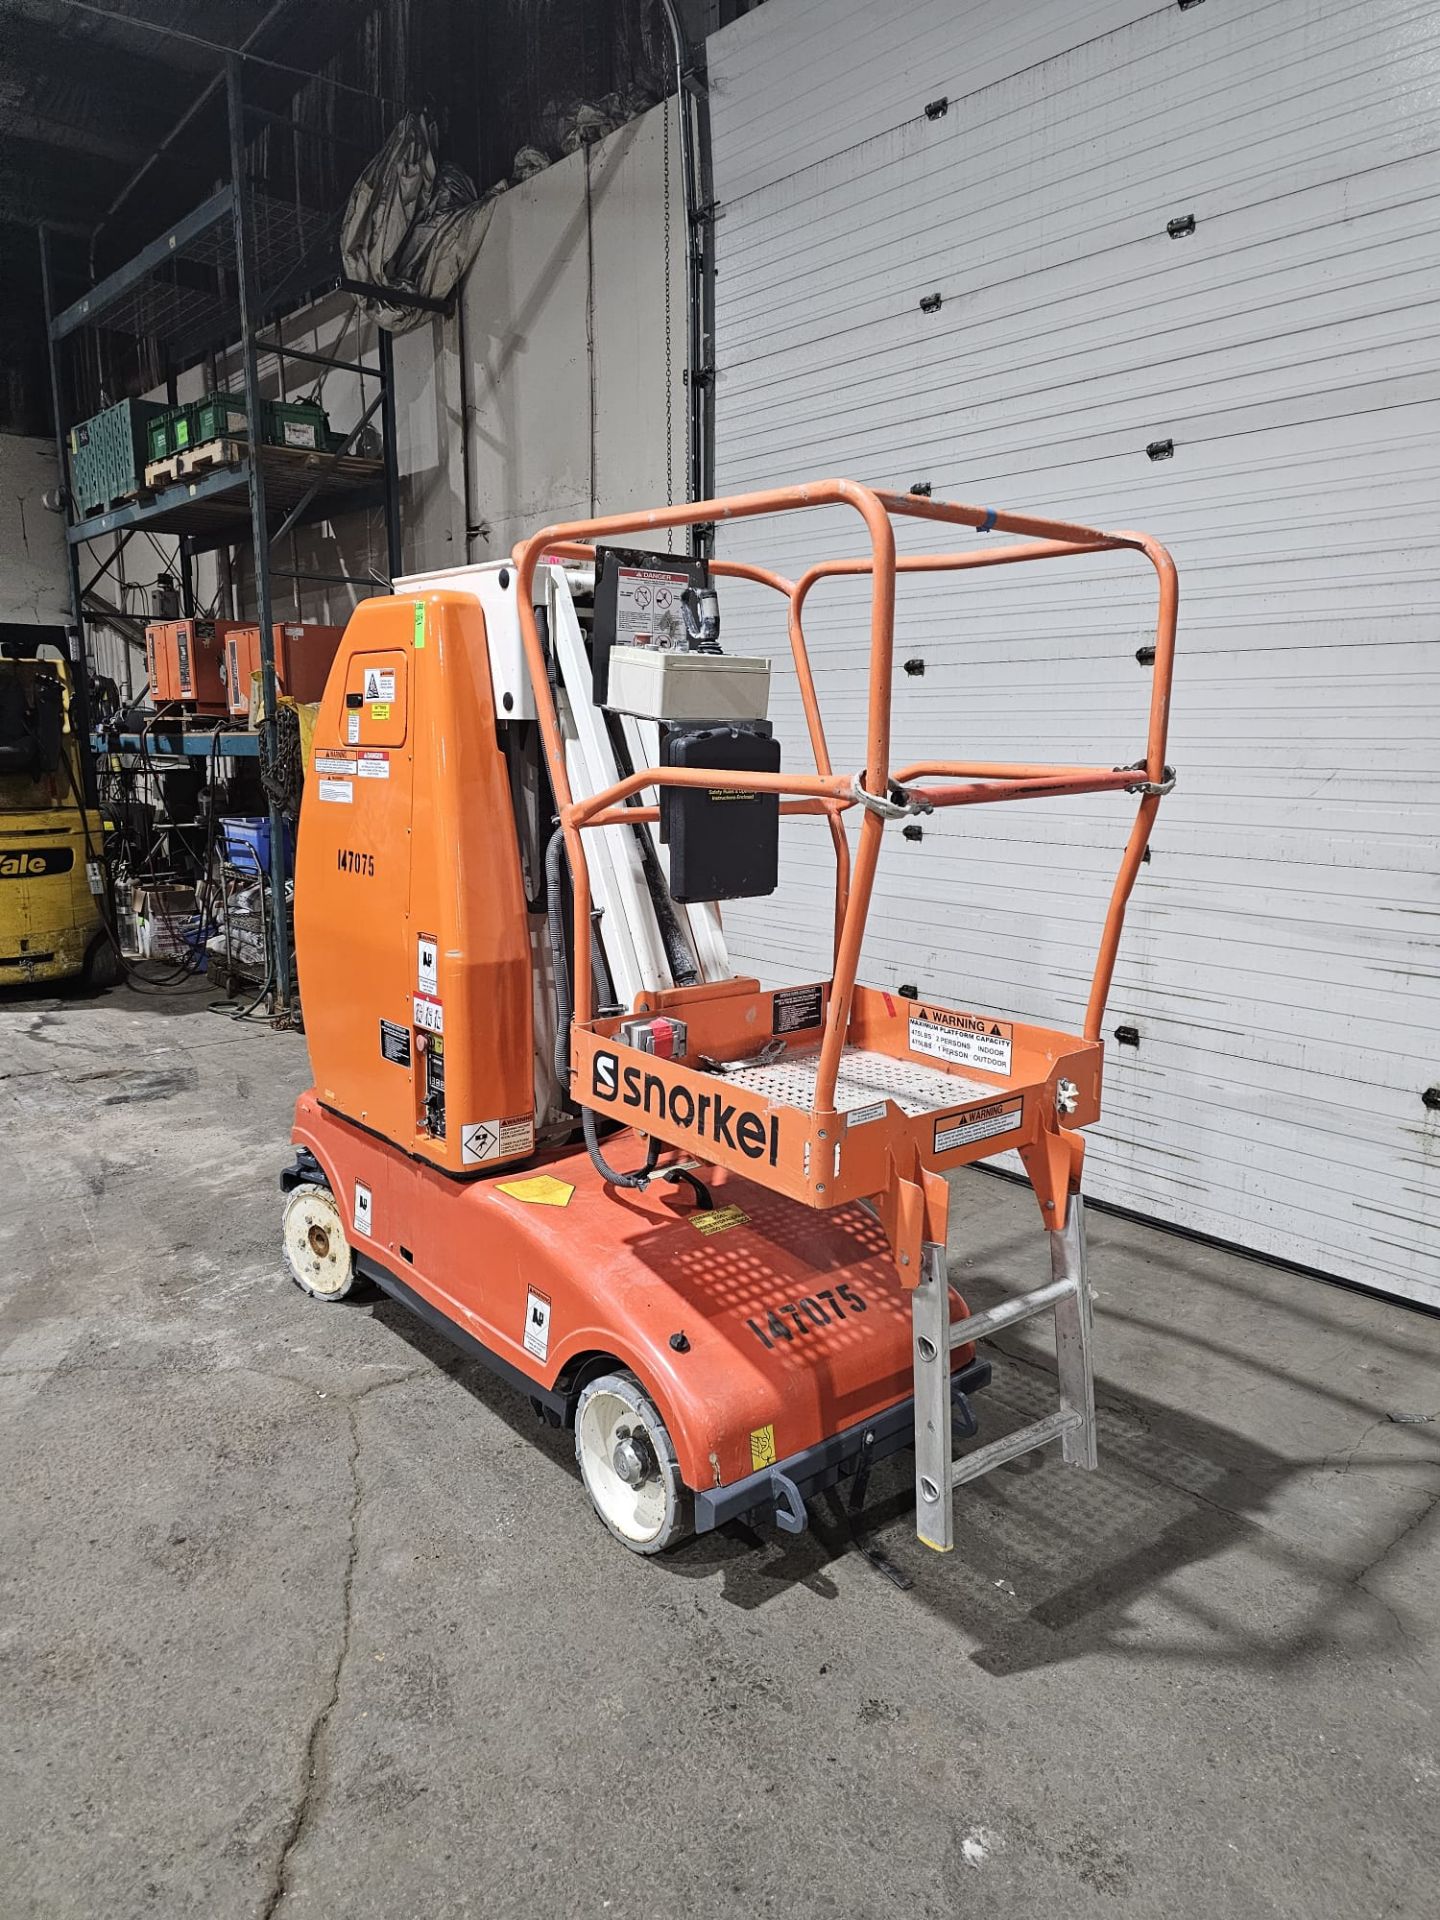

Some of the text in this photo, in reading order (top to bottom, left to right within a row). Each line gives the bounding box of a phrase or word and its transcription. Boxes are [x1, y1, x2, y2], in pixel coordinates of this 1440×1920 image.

[643, 572, 672, 581] DANGER
[337, 848, 375, 877] 147075
[932, 1011, 985, 1032] WARNING
[910, 1019, 1010, 1047] MAXIMUM PLATFORM CAPACITY
[940, 1037, 971, 1049] PERSONS
[978, 1045, 1004, 1057] INDOOR
[942, 1047, 969, 1059] PERSON
[973, 1054, 1007, 1068] OUTDOOR
[969, 1104, 1003, 1122] WARNING
[746, 1283, 868, 1349] 147075
